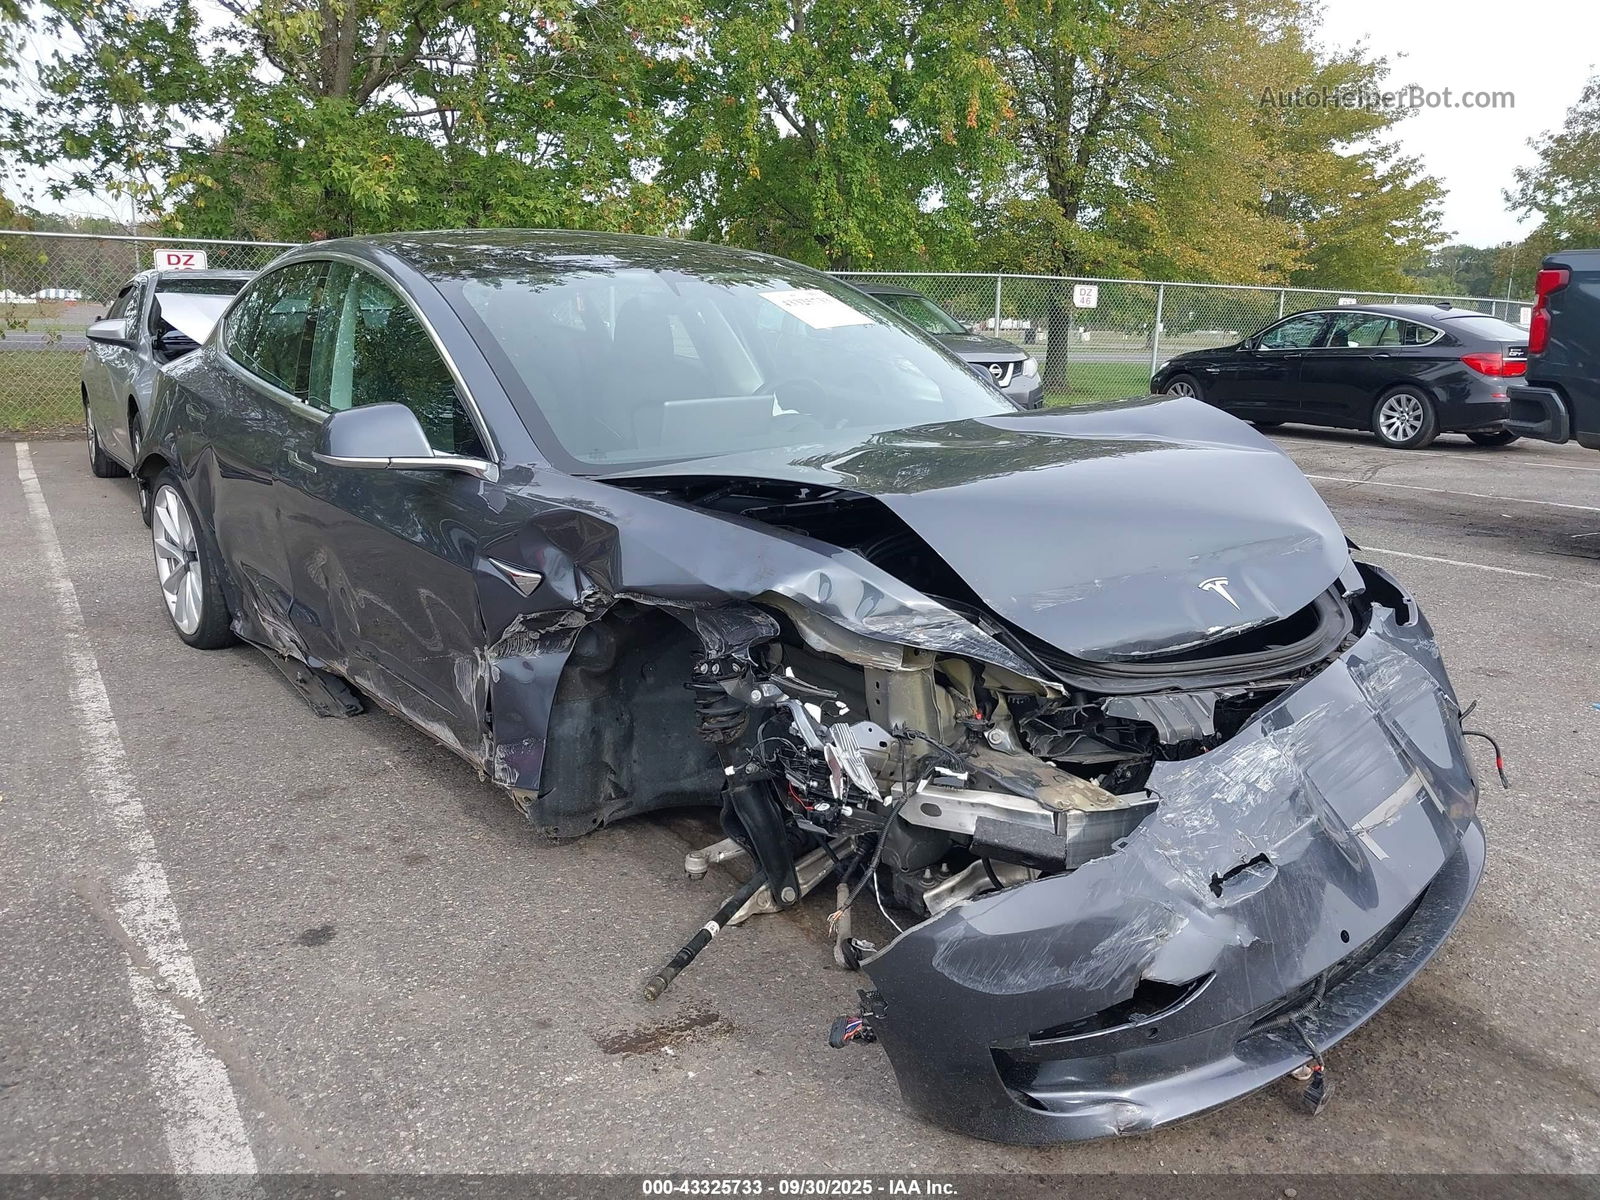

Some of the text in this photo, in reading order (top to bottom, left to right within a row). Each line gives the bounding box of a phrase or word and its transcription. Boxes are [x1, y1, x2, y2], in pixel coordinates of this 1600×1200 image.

[167, 254, 195, 266] DZ
[1079, 288, 1093, 297] DZ
[1079, 297, 1091, 305] 46
